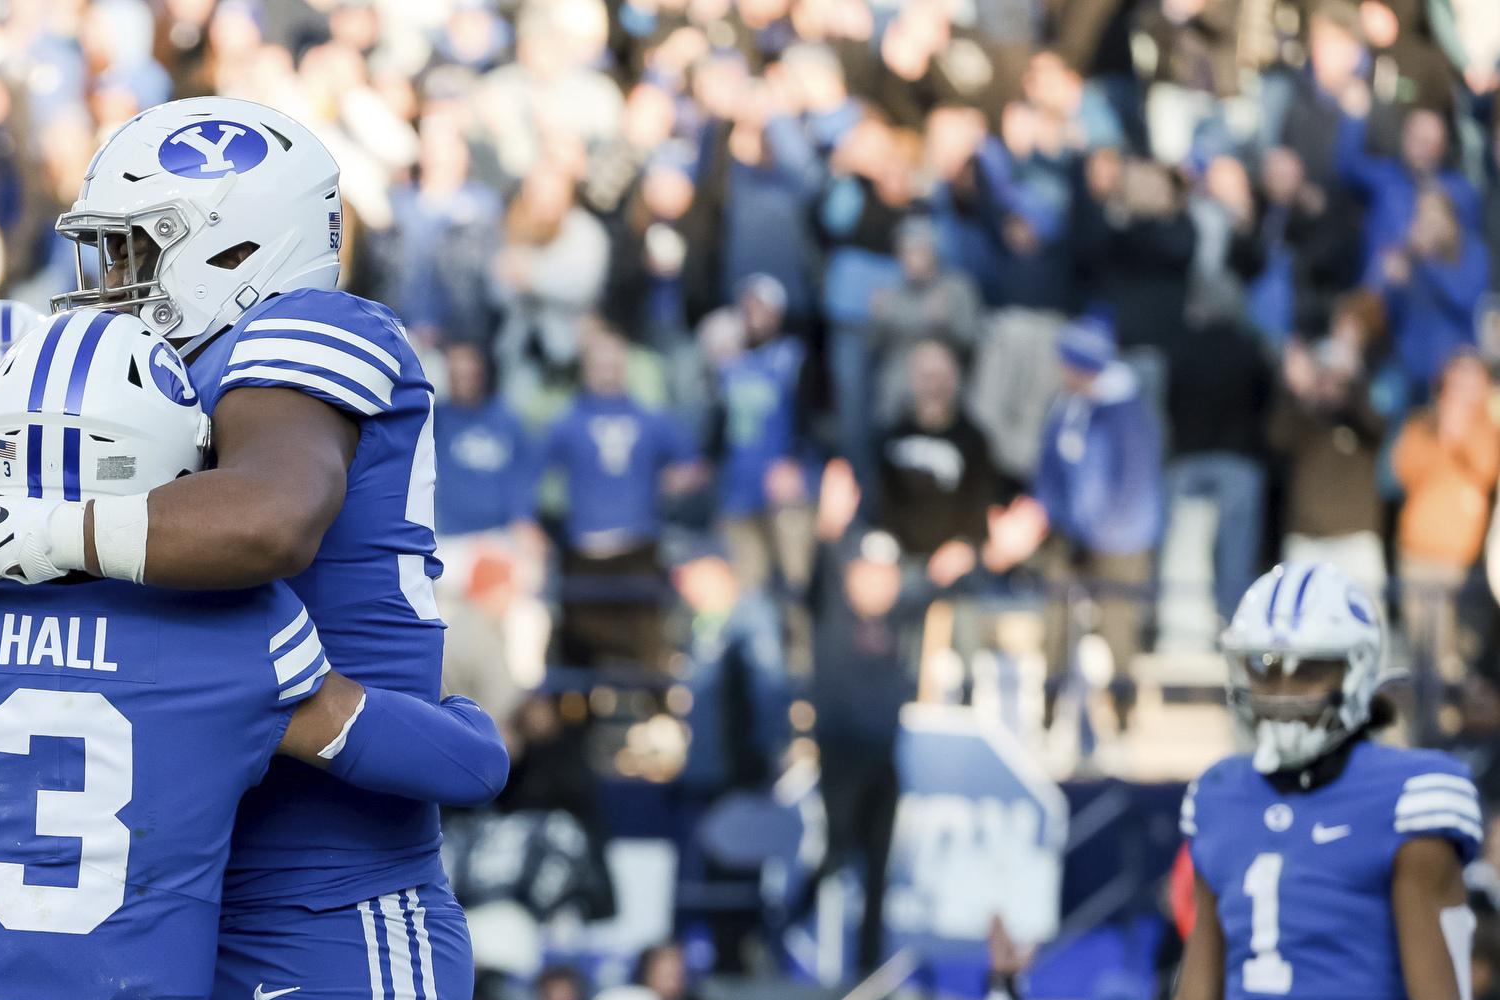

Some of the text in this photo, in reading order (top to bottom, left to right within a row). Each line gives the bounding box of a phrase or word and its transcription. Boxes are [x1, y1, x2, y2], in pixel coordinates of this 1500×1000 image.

[169, 124, 247, 173] Y
[329, 231, 340, 249] 52
[3, 461, 12, 478] 3
[1242, 852, 1293, 995] 1
